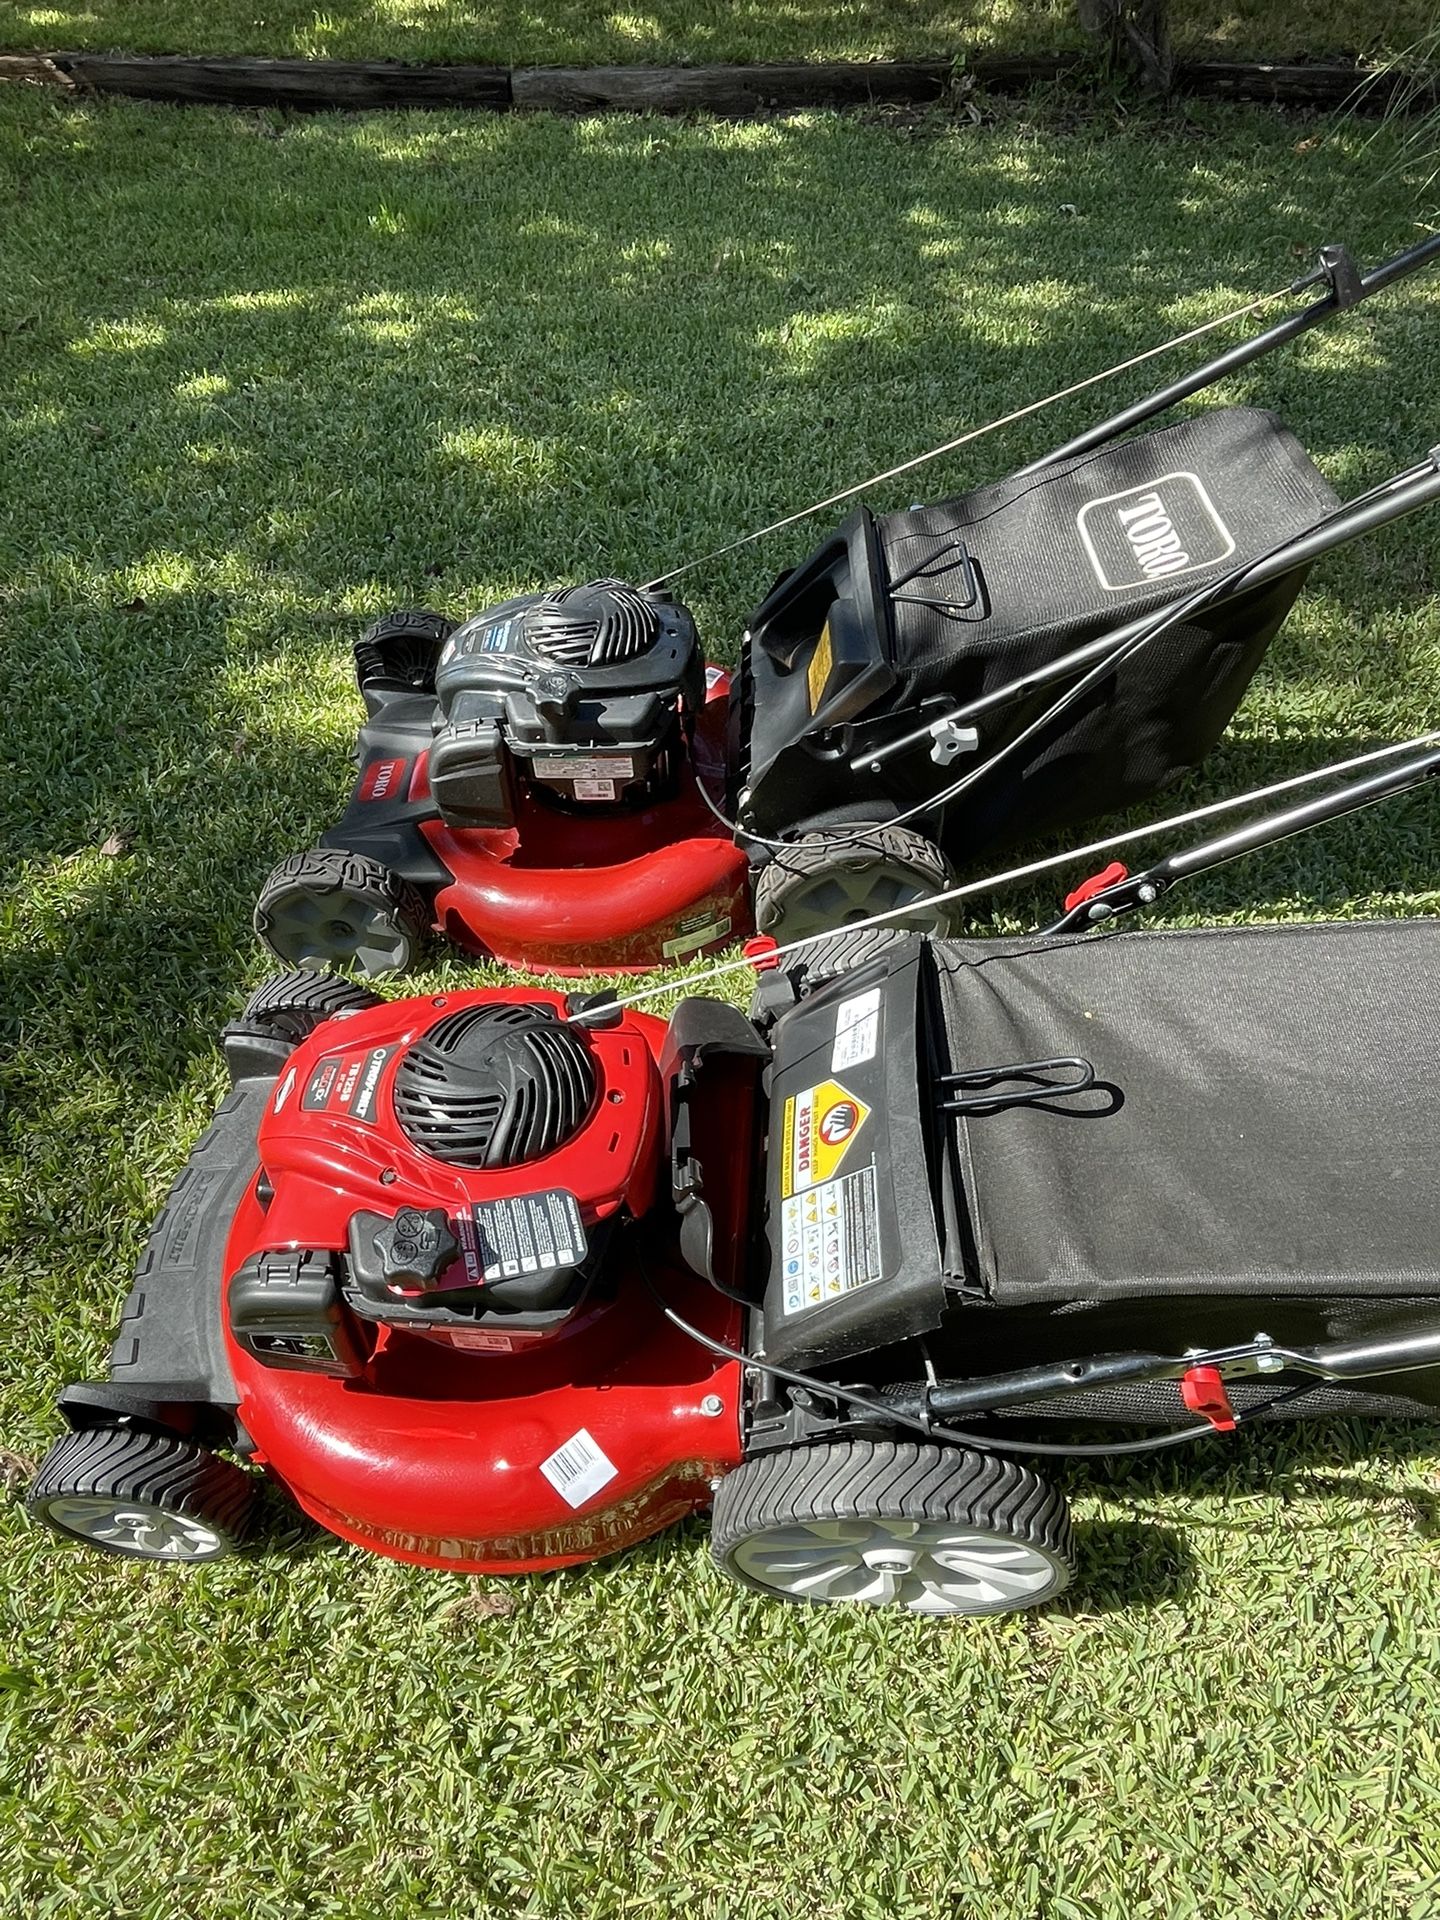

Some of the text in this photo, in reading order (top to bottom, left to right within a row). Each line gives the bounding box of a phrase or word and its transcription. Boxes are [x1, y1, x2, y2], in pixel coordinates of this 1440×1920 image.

[1117, 491, 1189, 578] TORO
[372, 761, 394, 798] TORO
[798, 1105, 811, 1172] DANGER
